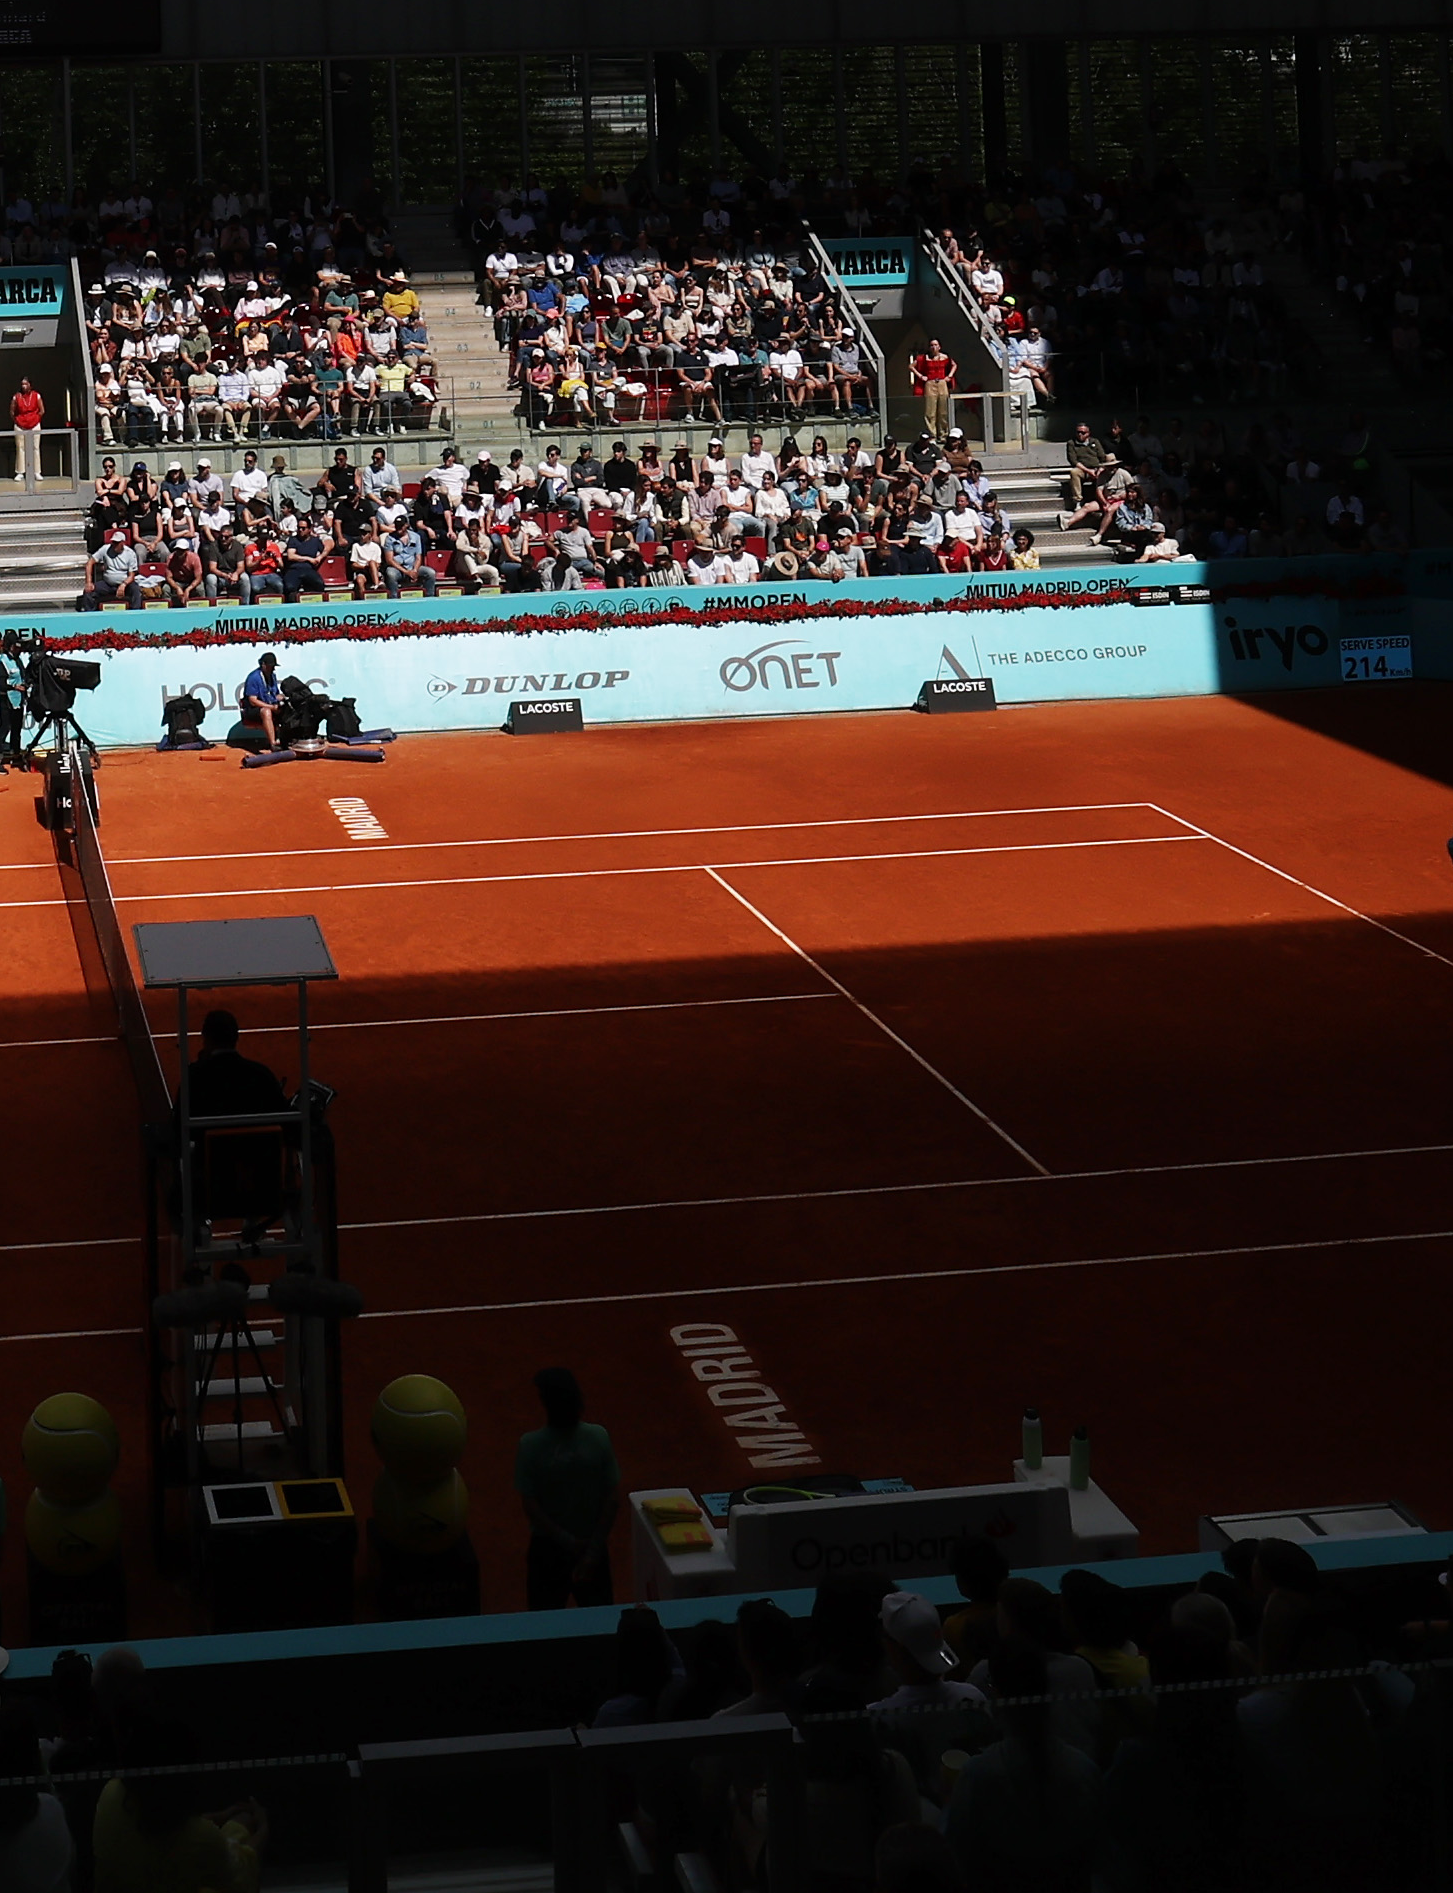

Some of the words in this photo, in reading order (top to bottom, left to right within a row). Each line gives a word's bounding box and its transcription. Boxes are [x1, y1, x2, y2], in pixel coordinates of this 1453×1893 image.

[966, 583, 1018, 599] MUTUA
[1022, 581, 1082, 594] MADRID
[1086, 578, 1130, 592] OPEN
[703, 593, 808, 611] #MMOPEN
[215, 617, 269, 634] MUTUA
[274, 615, 338, 630] MADRID
[343, 613, 389, 627] OPEN
[1224, 616, 1330, 671] iryo
[1341, 638, 1374, 651] SERVE
[1376, 637, 1410, 649] SPEED
[988, 652, 1019, 665] THE
[1024, 647, 1088, 663] ADECCO
[1093, 645, 1148, 660] GROUP
[1344, 655, 1388, 679] 214
[461, 670, 630, 695] DUNLOP
[933, 681, 987, 694] LACOSTE
[519, 701, 574, 715] LACOSTE
[328, 797, 389, 840] MADRID
[668, 1321, 823, 1470] MADRID
[791, 1527, 968, 1573] Openban
